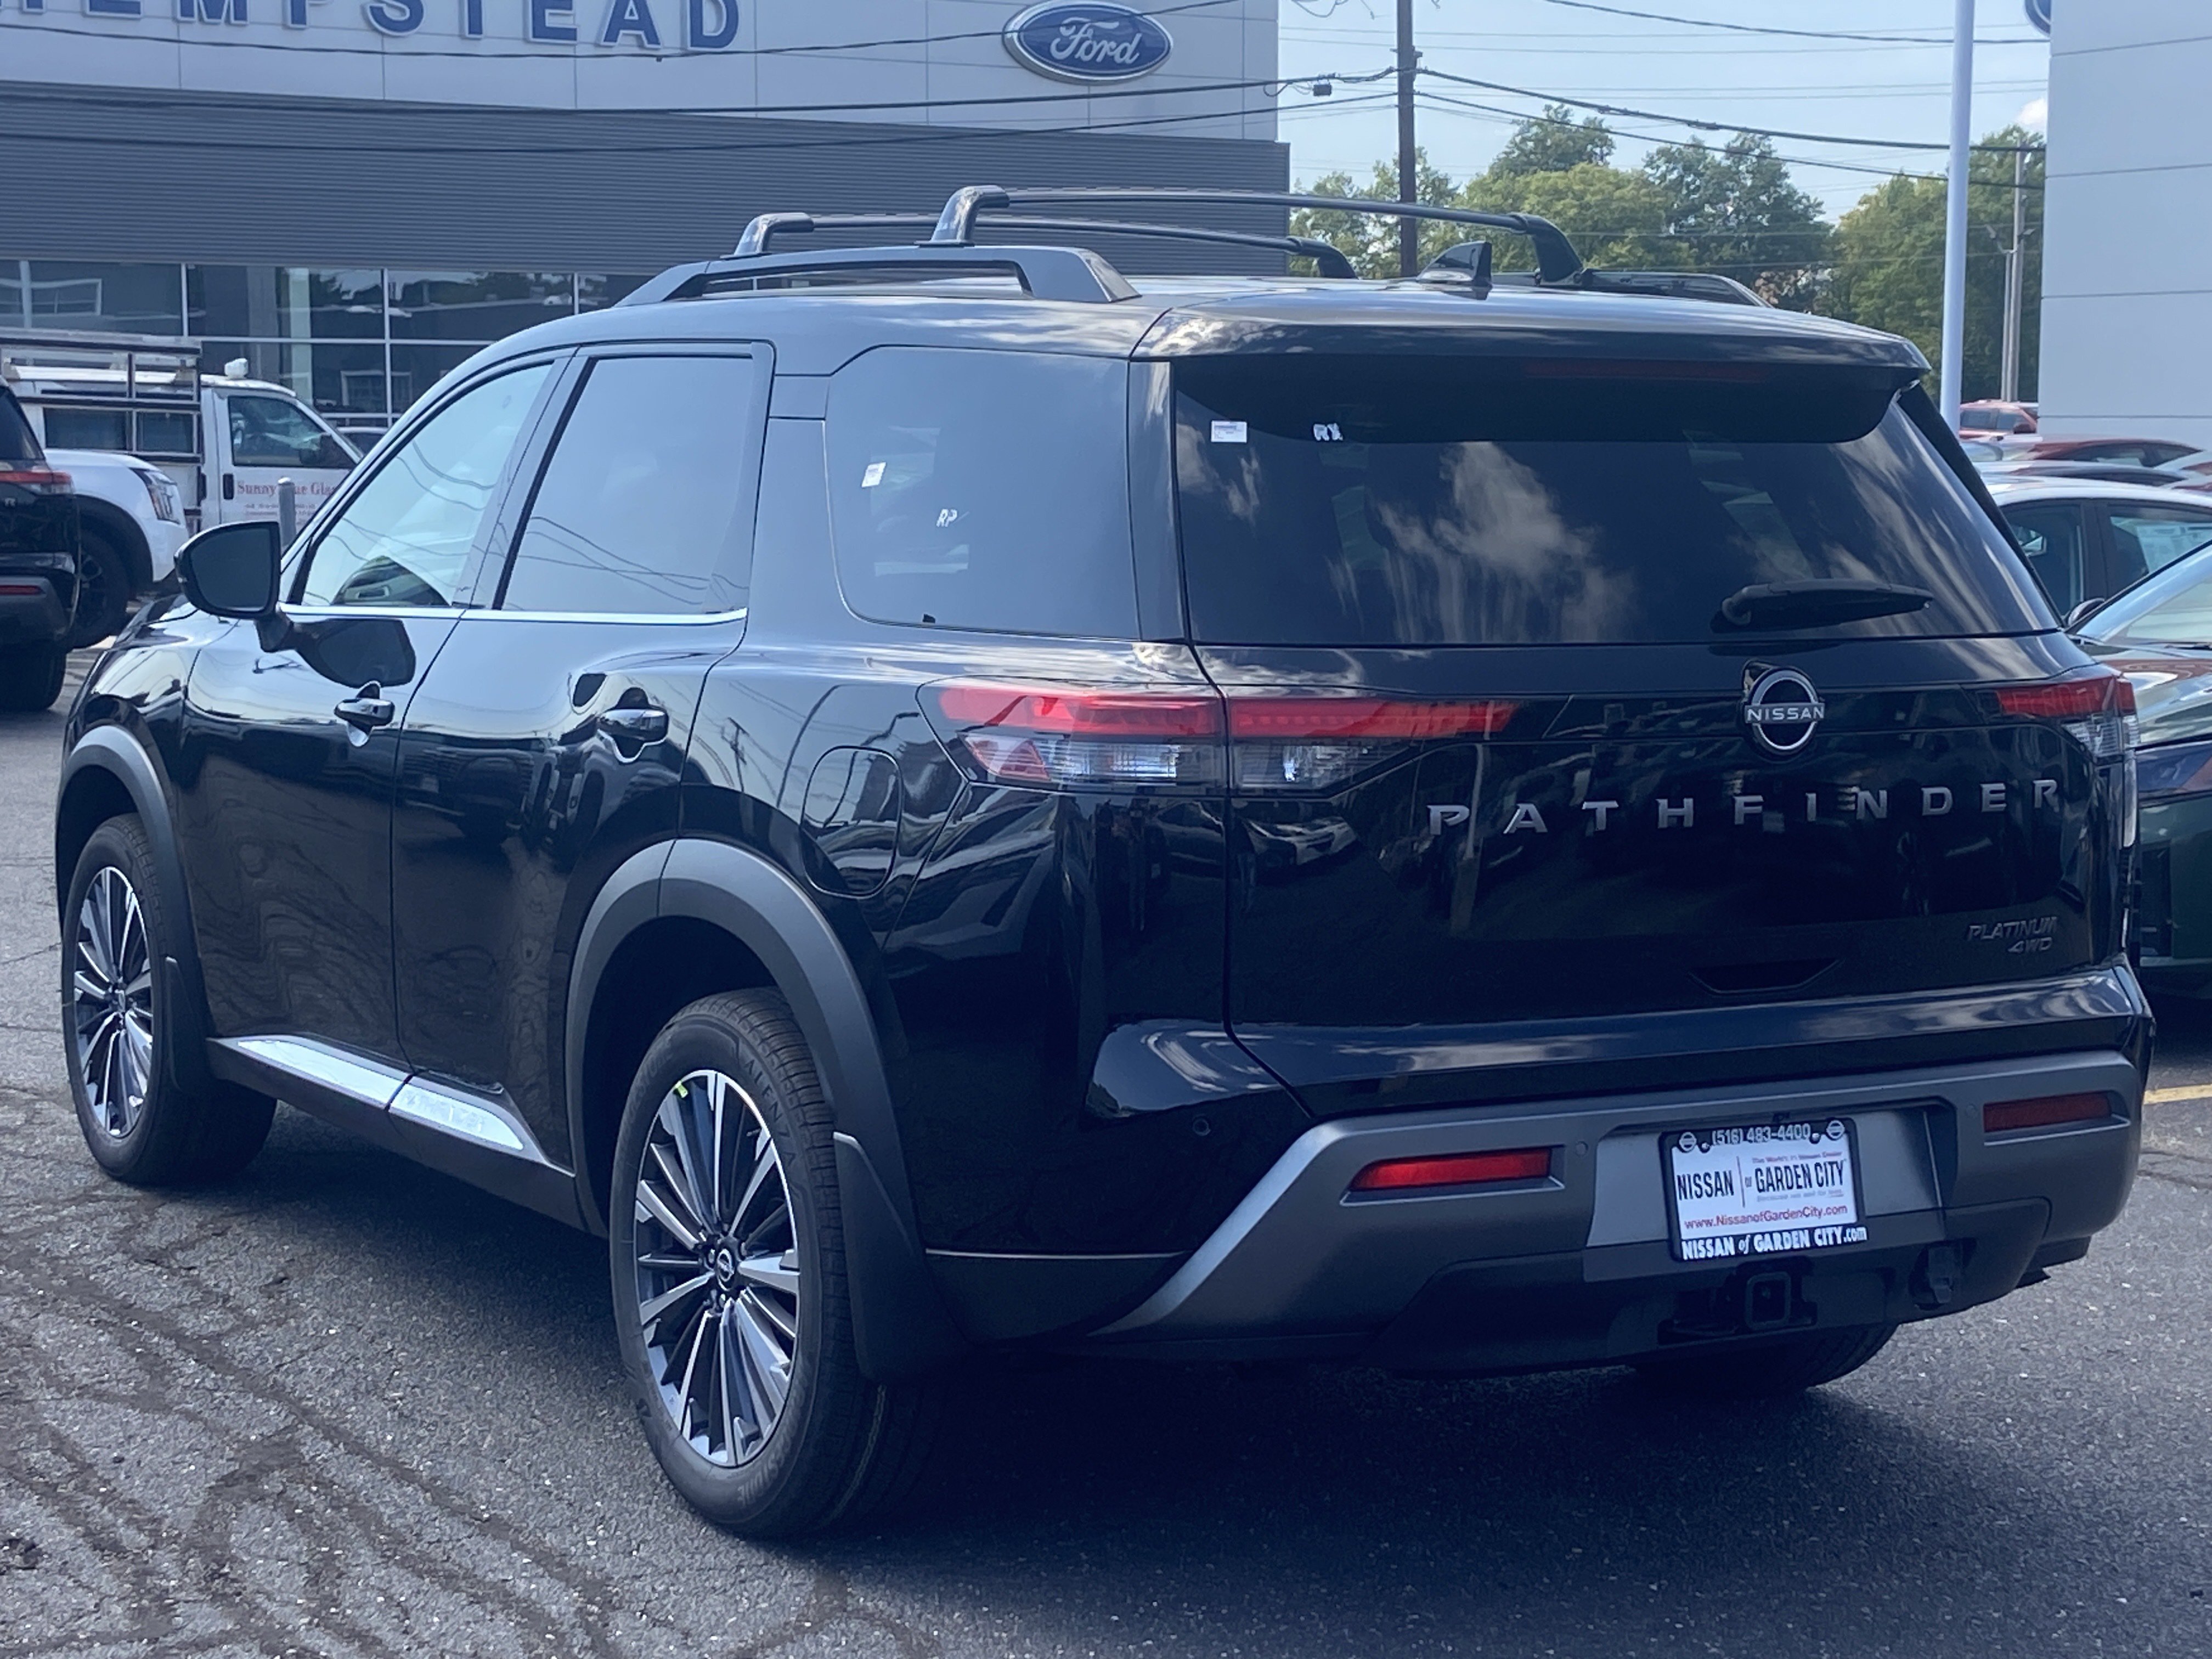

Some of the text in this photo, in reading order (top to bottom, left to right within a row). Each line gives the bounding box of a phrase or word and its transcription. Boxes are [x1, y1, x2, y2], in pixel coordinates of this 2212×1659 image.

[1050, 17, 1142, 64] Ford
[1747, 706, 1825, 721] NISSAN
[1427, 780, 2059, 836] PATHFINDER
[1967, 917, 2057, 941] PLATINUM
[2007, 936, 2052, 953] 4WD
[1712, 1123, 1811, 1145] (516) 483-4400
[1677, 1170, 1734, 1201] NISSAN
[1755, 1163, 1813, 1193] GARDEN
[1814, 1160, 1844, 1187] CITY
[1684, 1205, 1848, 1229] www.NissanofGardenCity.com
[1681, 1236, 1735, 1260] NISSAN
[1739, 1234, 1750, 1255] of
[1753, 1229, 1810, 1252] GARDEN
